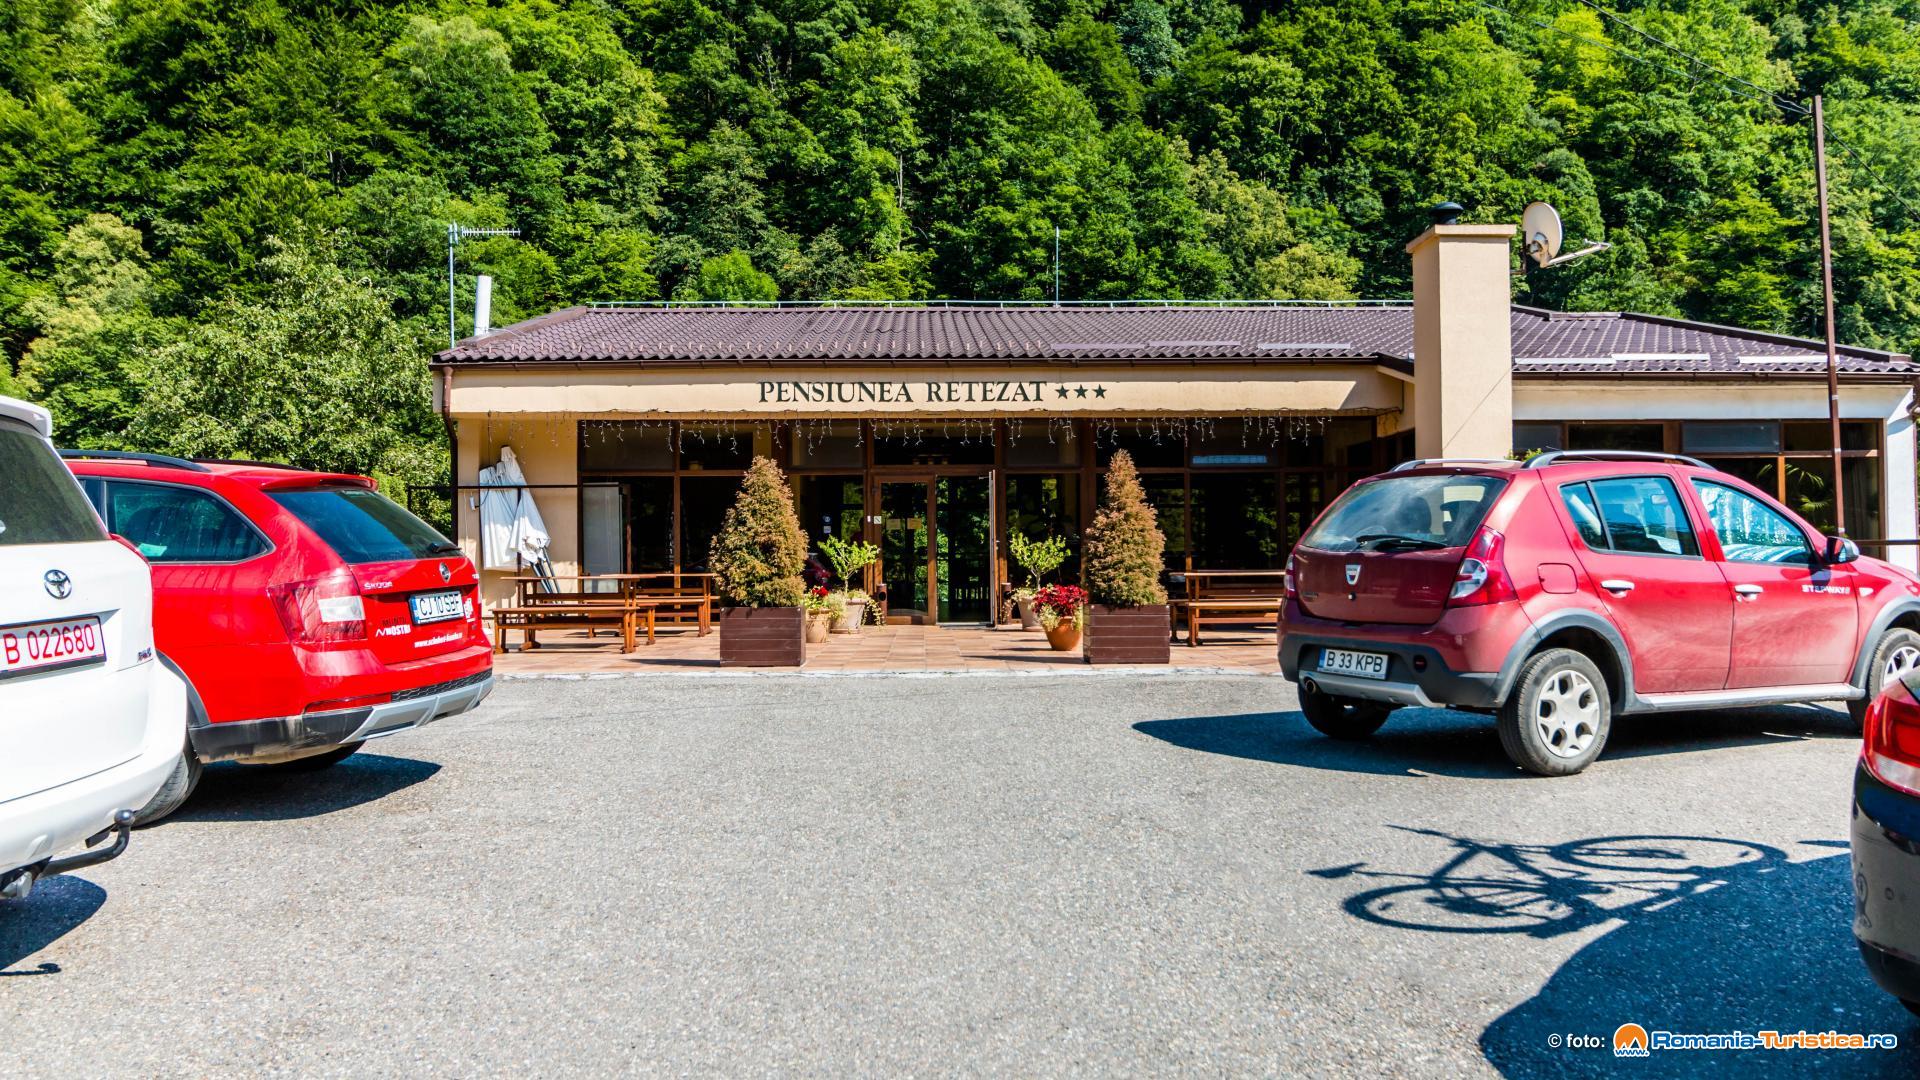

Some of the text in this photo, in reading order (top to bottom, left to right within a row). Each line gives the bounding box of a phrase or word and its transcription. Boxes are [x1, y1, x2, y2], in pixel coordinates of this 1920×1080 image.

[758, 381, 1048, 403] PENSIUNEA RETEZAT
[419, 597, 433, 616] CJ
[434, 595, 444, 613] 10
[3, 623, 95, 665] B 022680
[1326, 651, 1336, 667] B
[1338, 652, 1353, 669] 33
[1355, 654, 1384, 673] KPB
